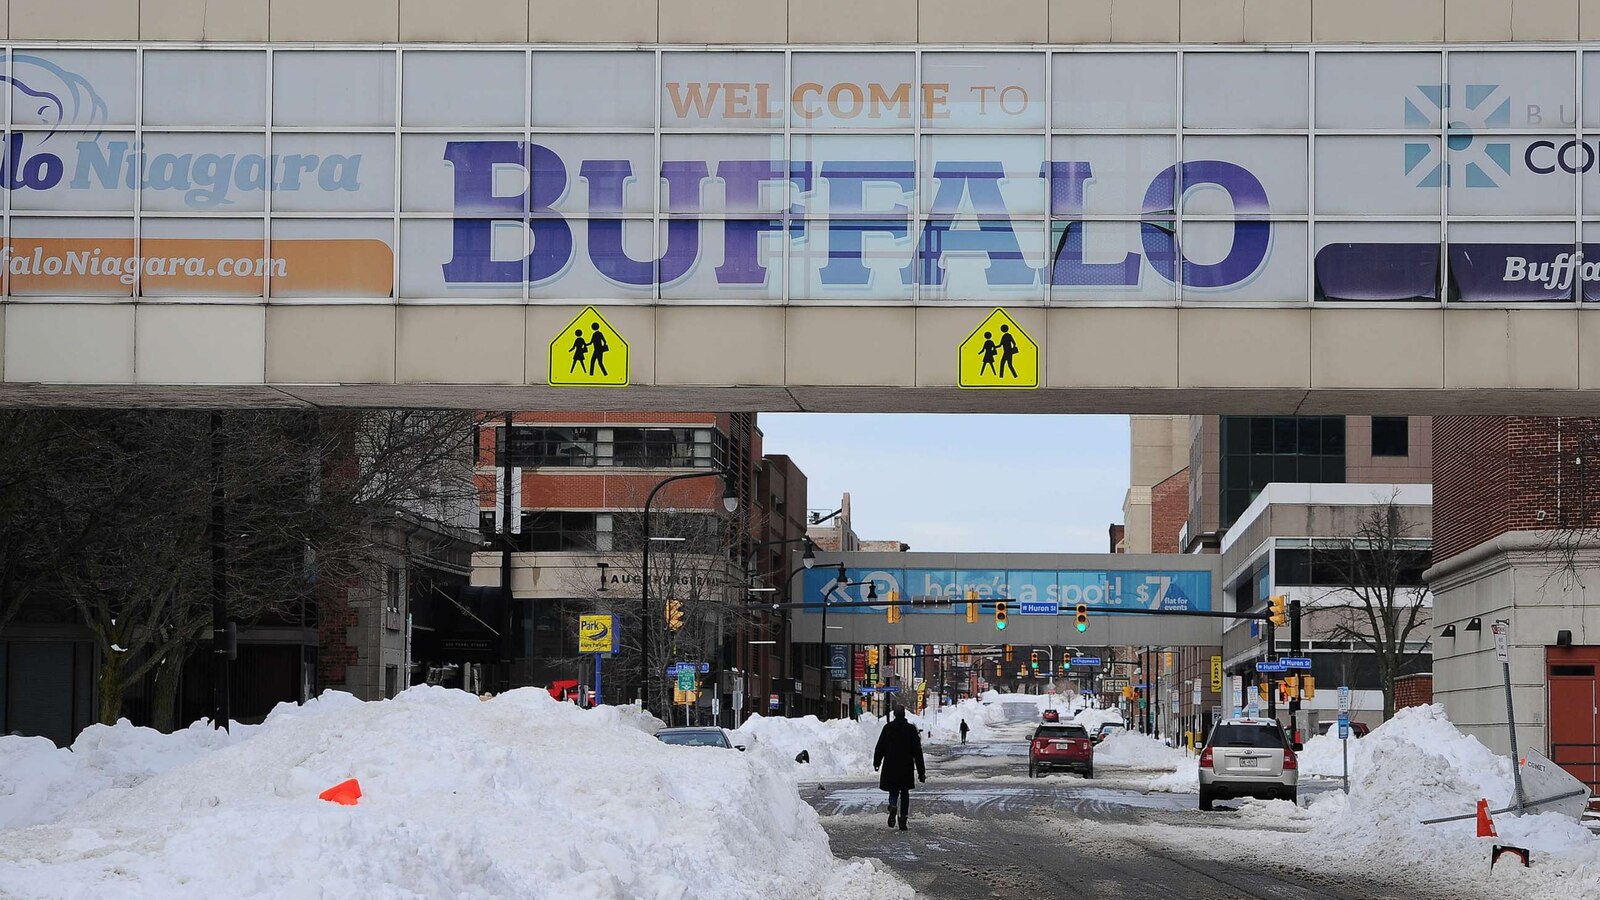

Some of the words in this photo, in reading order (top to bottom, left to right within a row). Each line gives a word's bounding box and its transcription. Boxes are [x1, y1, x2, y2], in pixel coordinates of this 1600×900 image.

[666, 83, 950, 119] WELCOME
[969, 86, 1029, 115] TO
[70, 141, 362, 209] Niagara
[1524, 140, 1600, 175] CO
[442, 141, 1274, 288] BUFFALO
[924, 574, 1011, 602] here's
[1020, 584, 1037, 602] a
[1046, 576, 1122, 608] spot!
[1136, 576, 1171, 609] $7
[1028, 604, 1050, 612] Huron
[581, 620, 599, 631] Park
